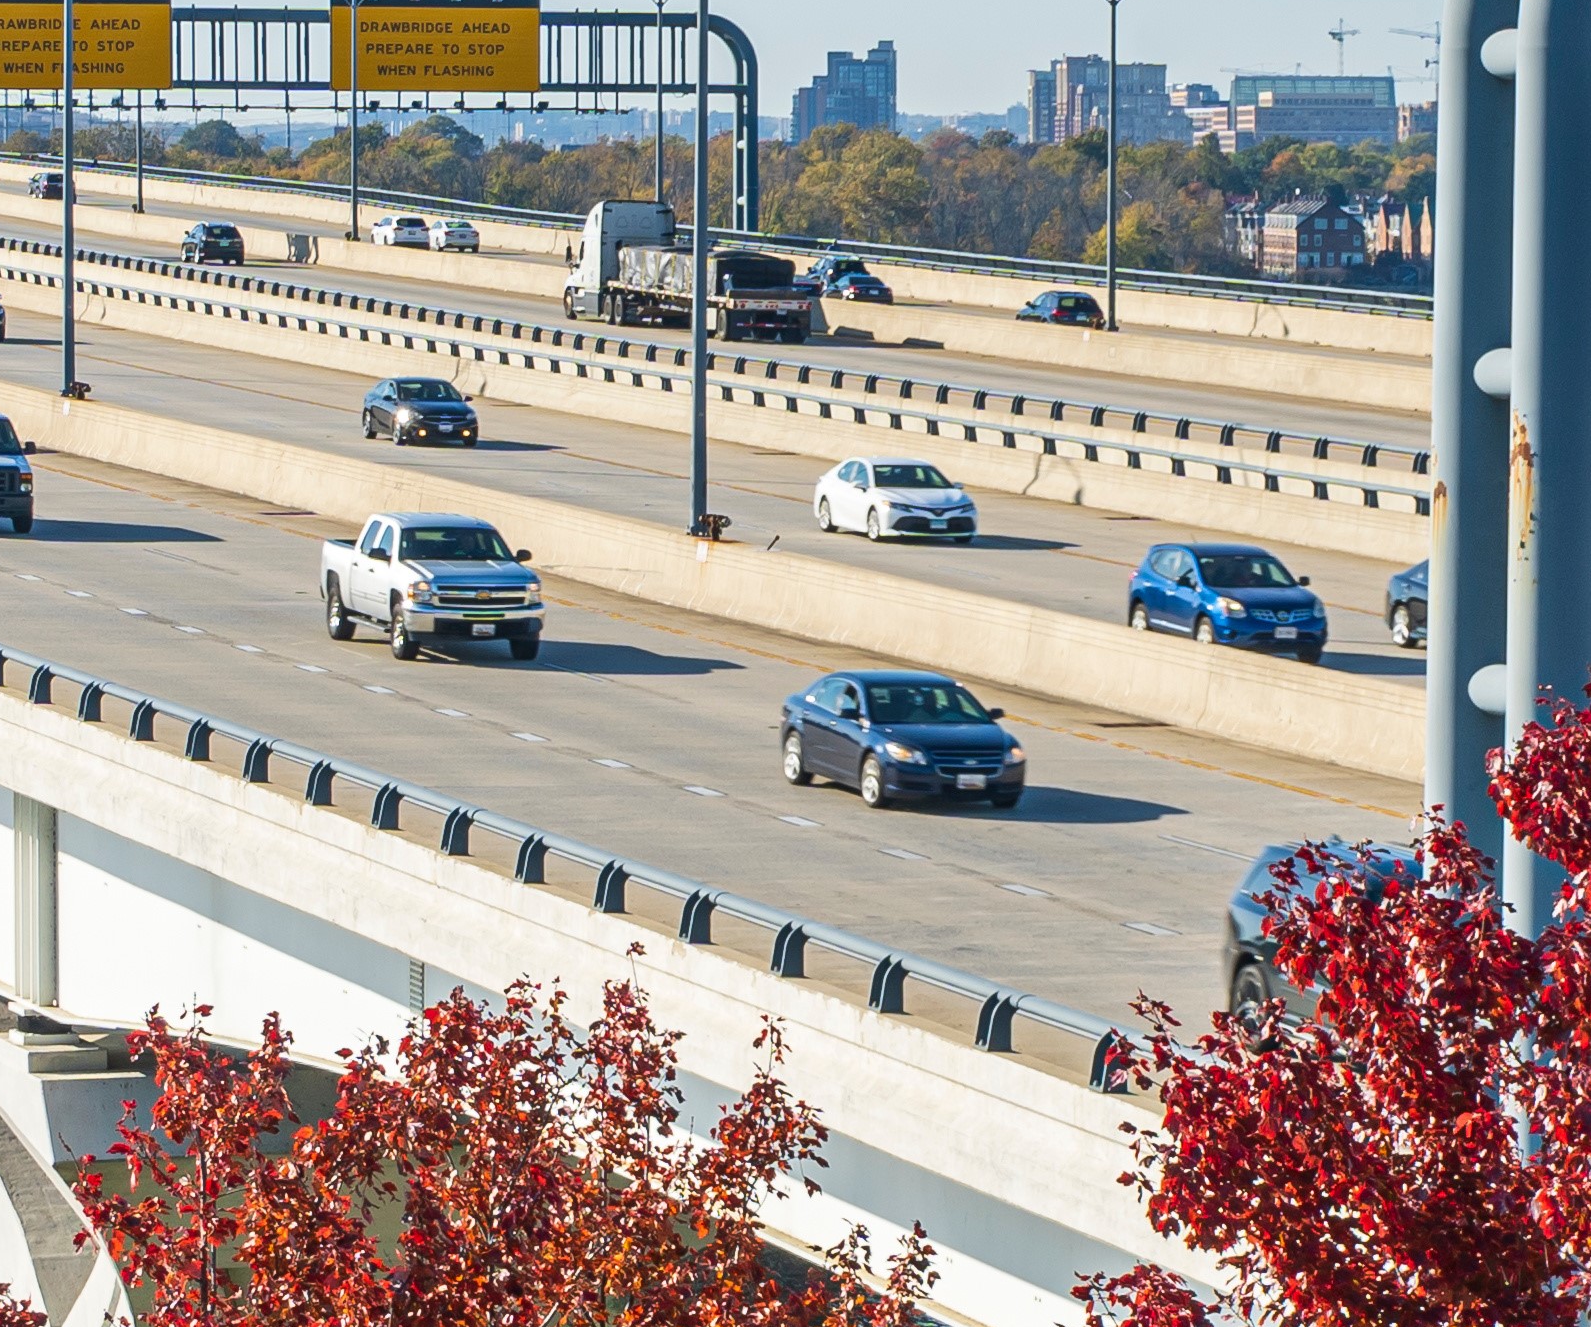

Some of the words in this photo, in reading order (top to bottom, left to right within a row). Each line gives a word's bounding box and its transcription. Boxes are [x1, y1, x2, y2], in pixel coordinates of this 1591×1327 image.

[90, 18, 141, 30] AHEAD
[360, 21, 453, 34] DRAWBRIDGE
[461, 21, 511, 34] AHEAD
[72, 40, 89, 52] TO
[97, 40, 135, 52] STOP
[366, 43, 433, 55] PREPARE
[442, 43, 460, 55] TO
[468, 43, 505, 55] STOP
[3, 62, 44, 74] WHEN
[377, 65, 416, 76] WHEN
[424, 65, 495, 77] FLASHING
